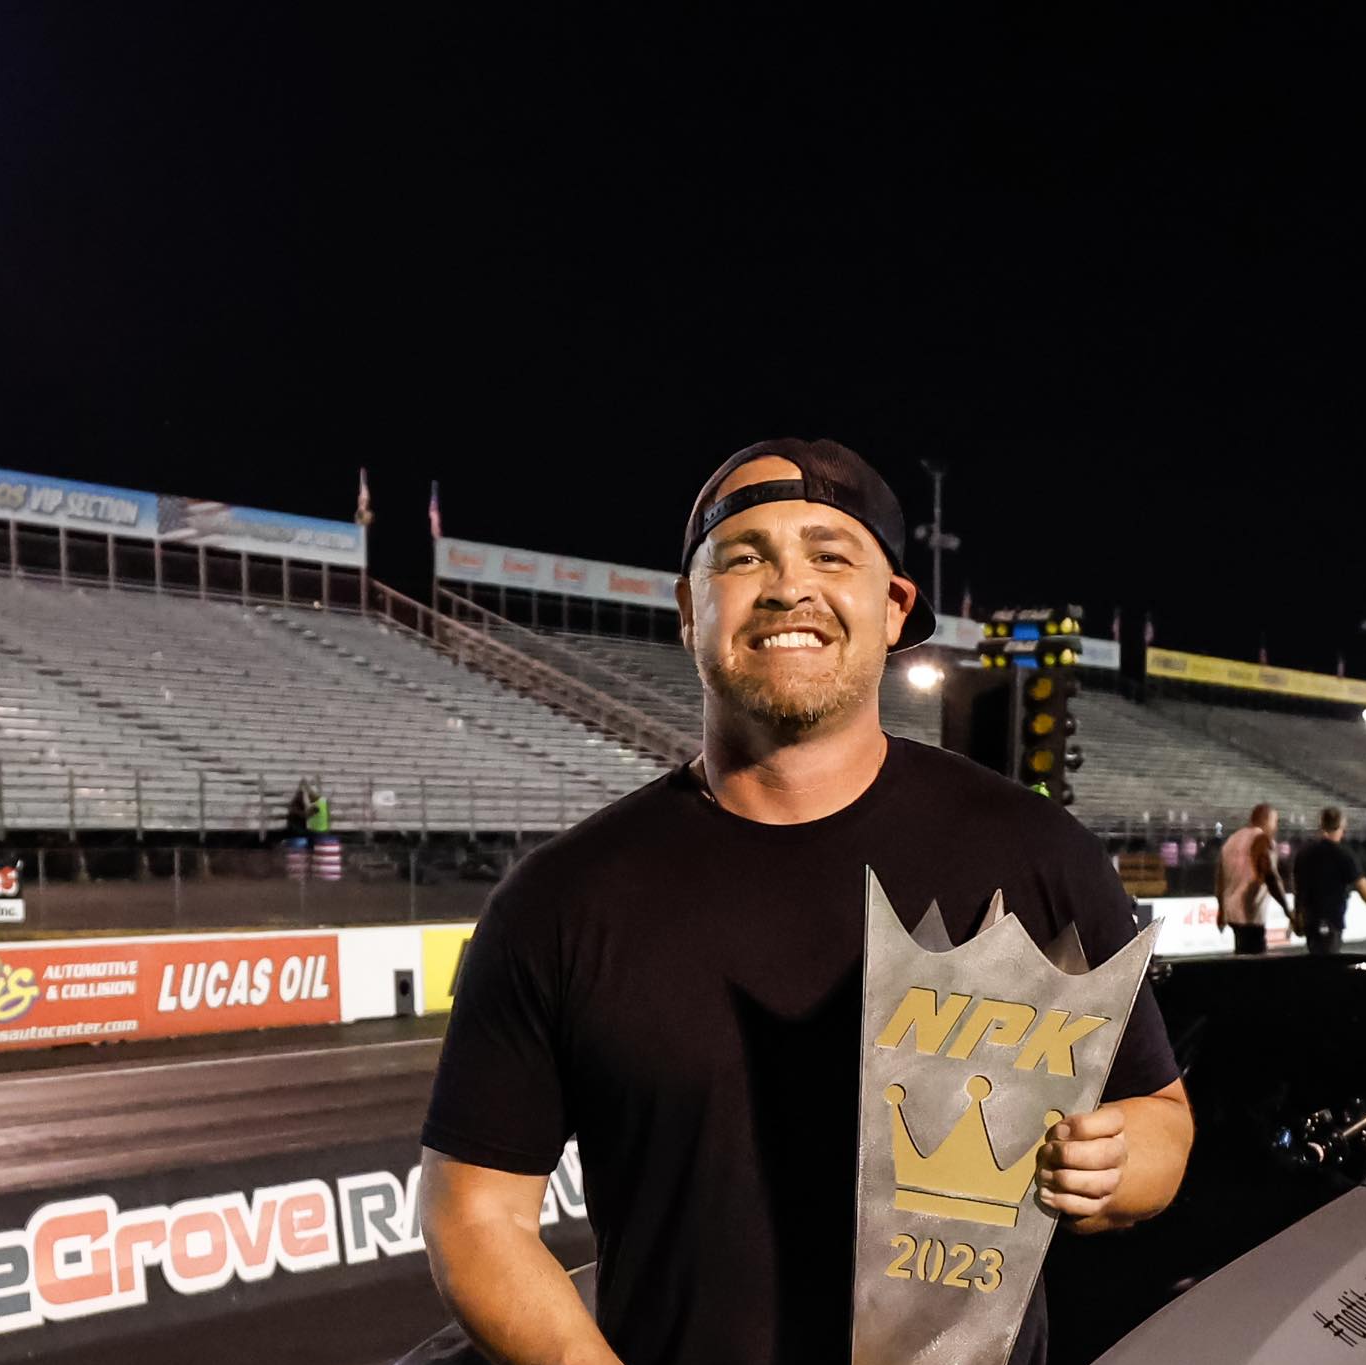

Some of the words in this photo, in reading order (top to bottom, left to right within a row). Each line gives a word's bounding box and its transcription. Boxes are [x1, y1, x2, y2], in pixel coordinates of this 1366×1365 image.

[43, 960, 139, 980] AUTOMOTIVE
[46, 983, 57, 1000] &
[61, 980, 137, 999] COLLISION
[157, 956, 273, 1012] LUCAS
[278, 954, 331, 1004] OIL
[874, 986, 1113, 1077] NPK
[885, 1233, 1005, 1294] 2023
